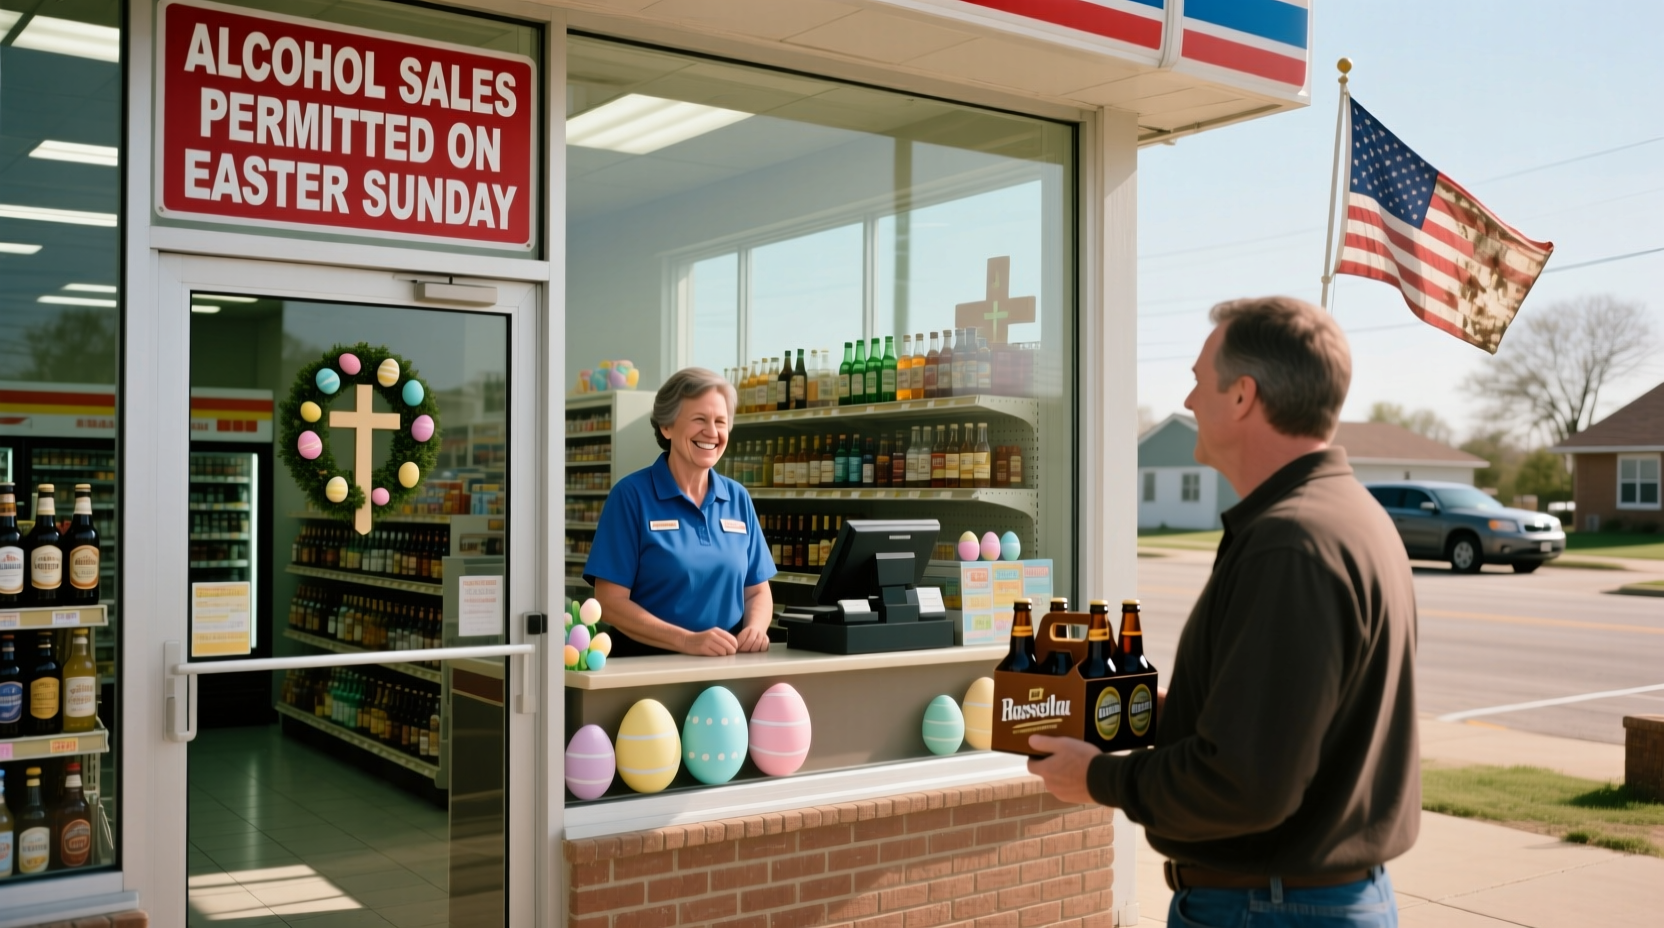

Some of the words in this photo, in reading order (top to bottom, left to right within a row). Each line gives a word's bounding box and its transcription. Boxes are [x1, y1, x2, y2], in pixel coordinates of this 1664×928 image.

[184, 22, 386, 99] ALCOHOL
[399, 57, 517, 117] SALES
[200, 87, 434, 163] PERMITTED
[447, 122, 501, 172] ON
[184, 148, 349, 214] EASTER
[362, 169, 517, 230] SUNDAY
